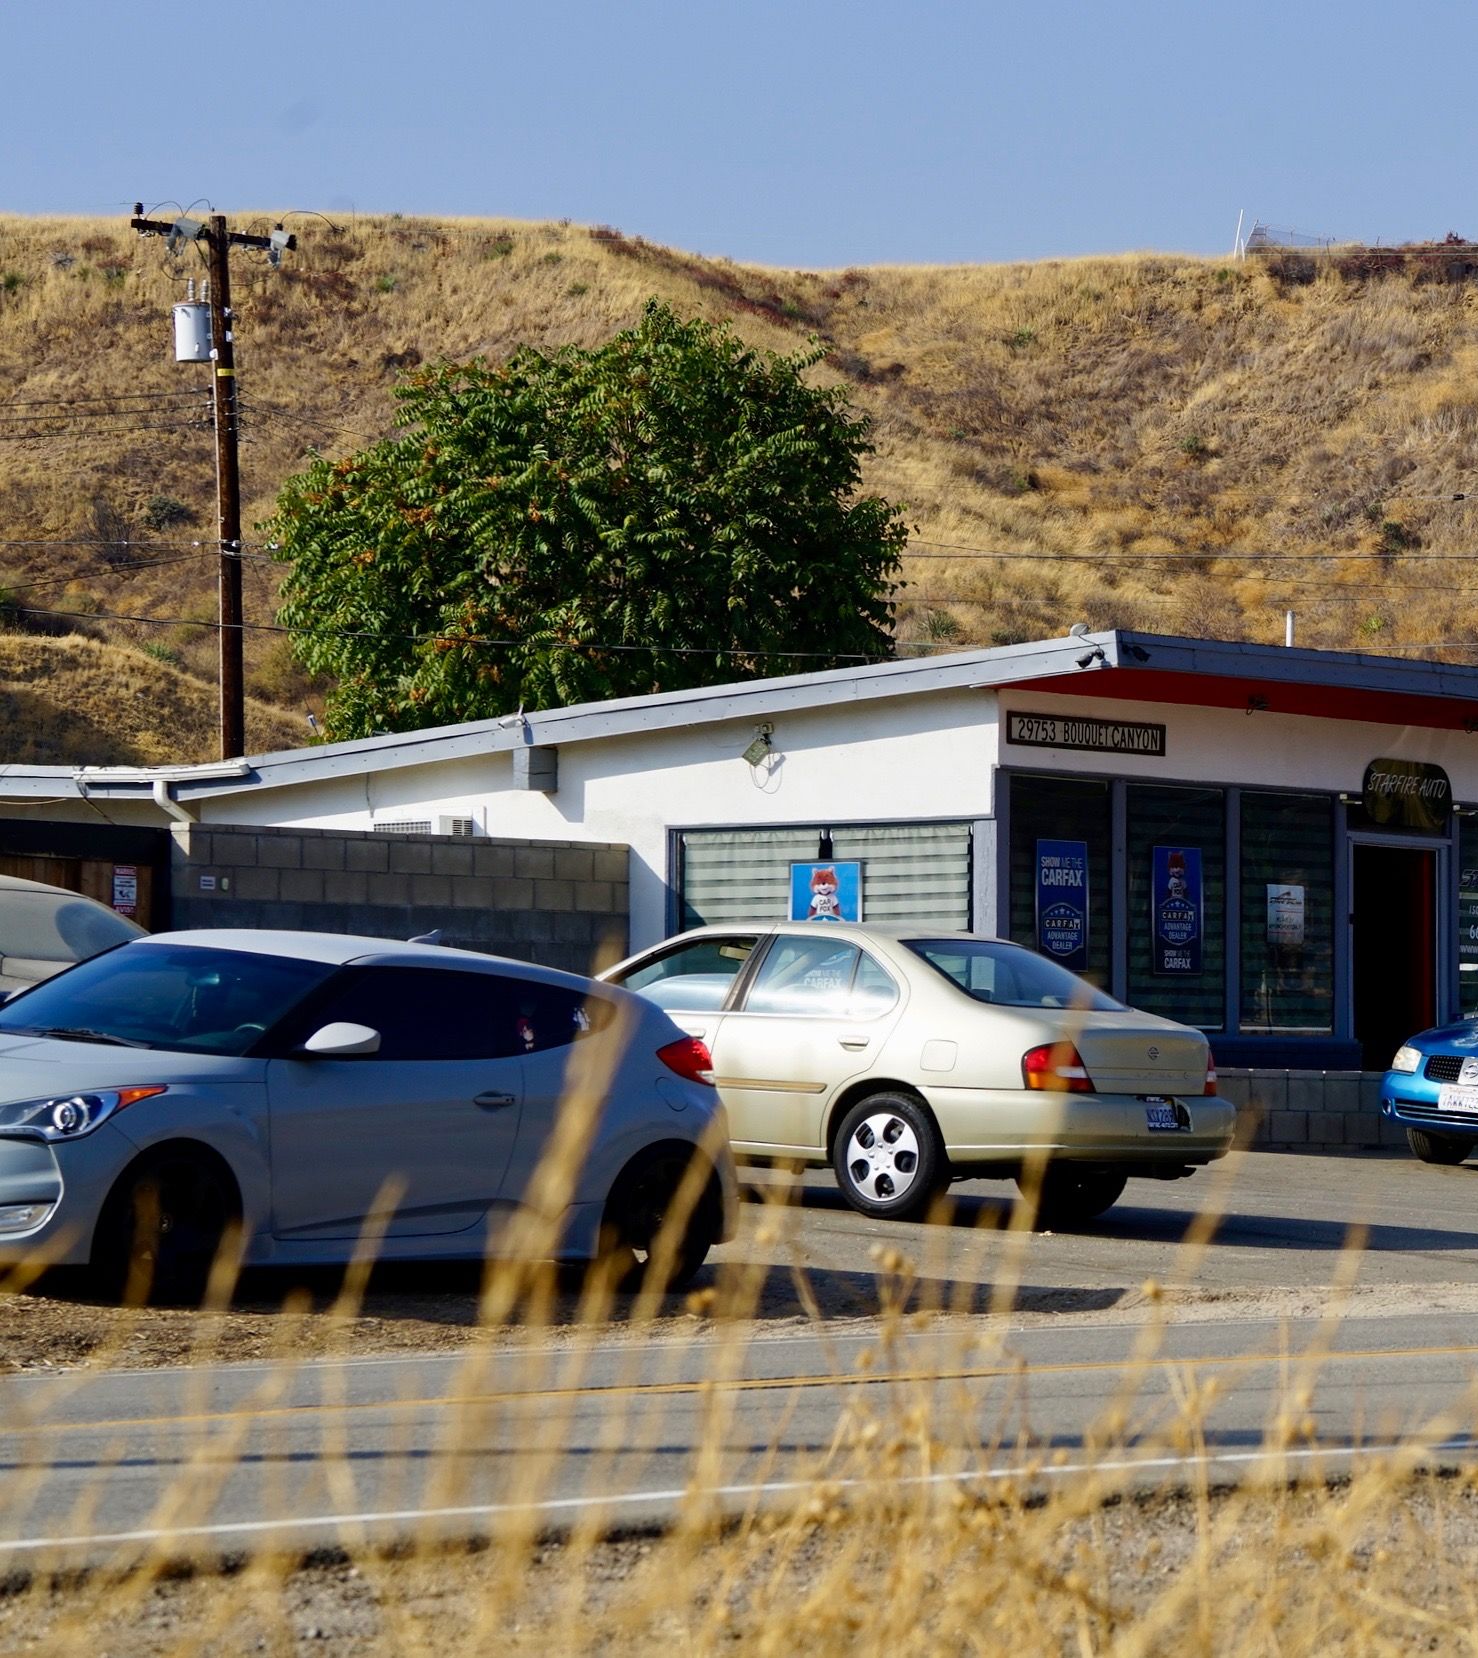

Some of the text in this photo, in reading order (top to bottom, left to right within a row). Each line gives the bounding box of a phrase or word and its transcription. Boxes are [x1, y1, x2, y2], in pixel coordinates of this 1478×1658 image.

[1018, 719, 1158, 750] 29753 BOUQUET CANYON
[1367, 772, 1447, 798] STARFIRE AUTO
[1041, 856, 1060, 868] SHOW
[1041, 868, 1084, 887] CARFAX
[1162, 911, 1194, 920] CARFAX
[1045, 919, 1080, 930] CARFAX
[1047, 931, 1079, 941] ADVANTAGE
[1052, 941, 1073, 950] DEALER
[1164, 957, 1191, 969] CARFAX
